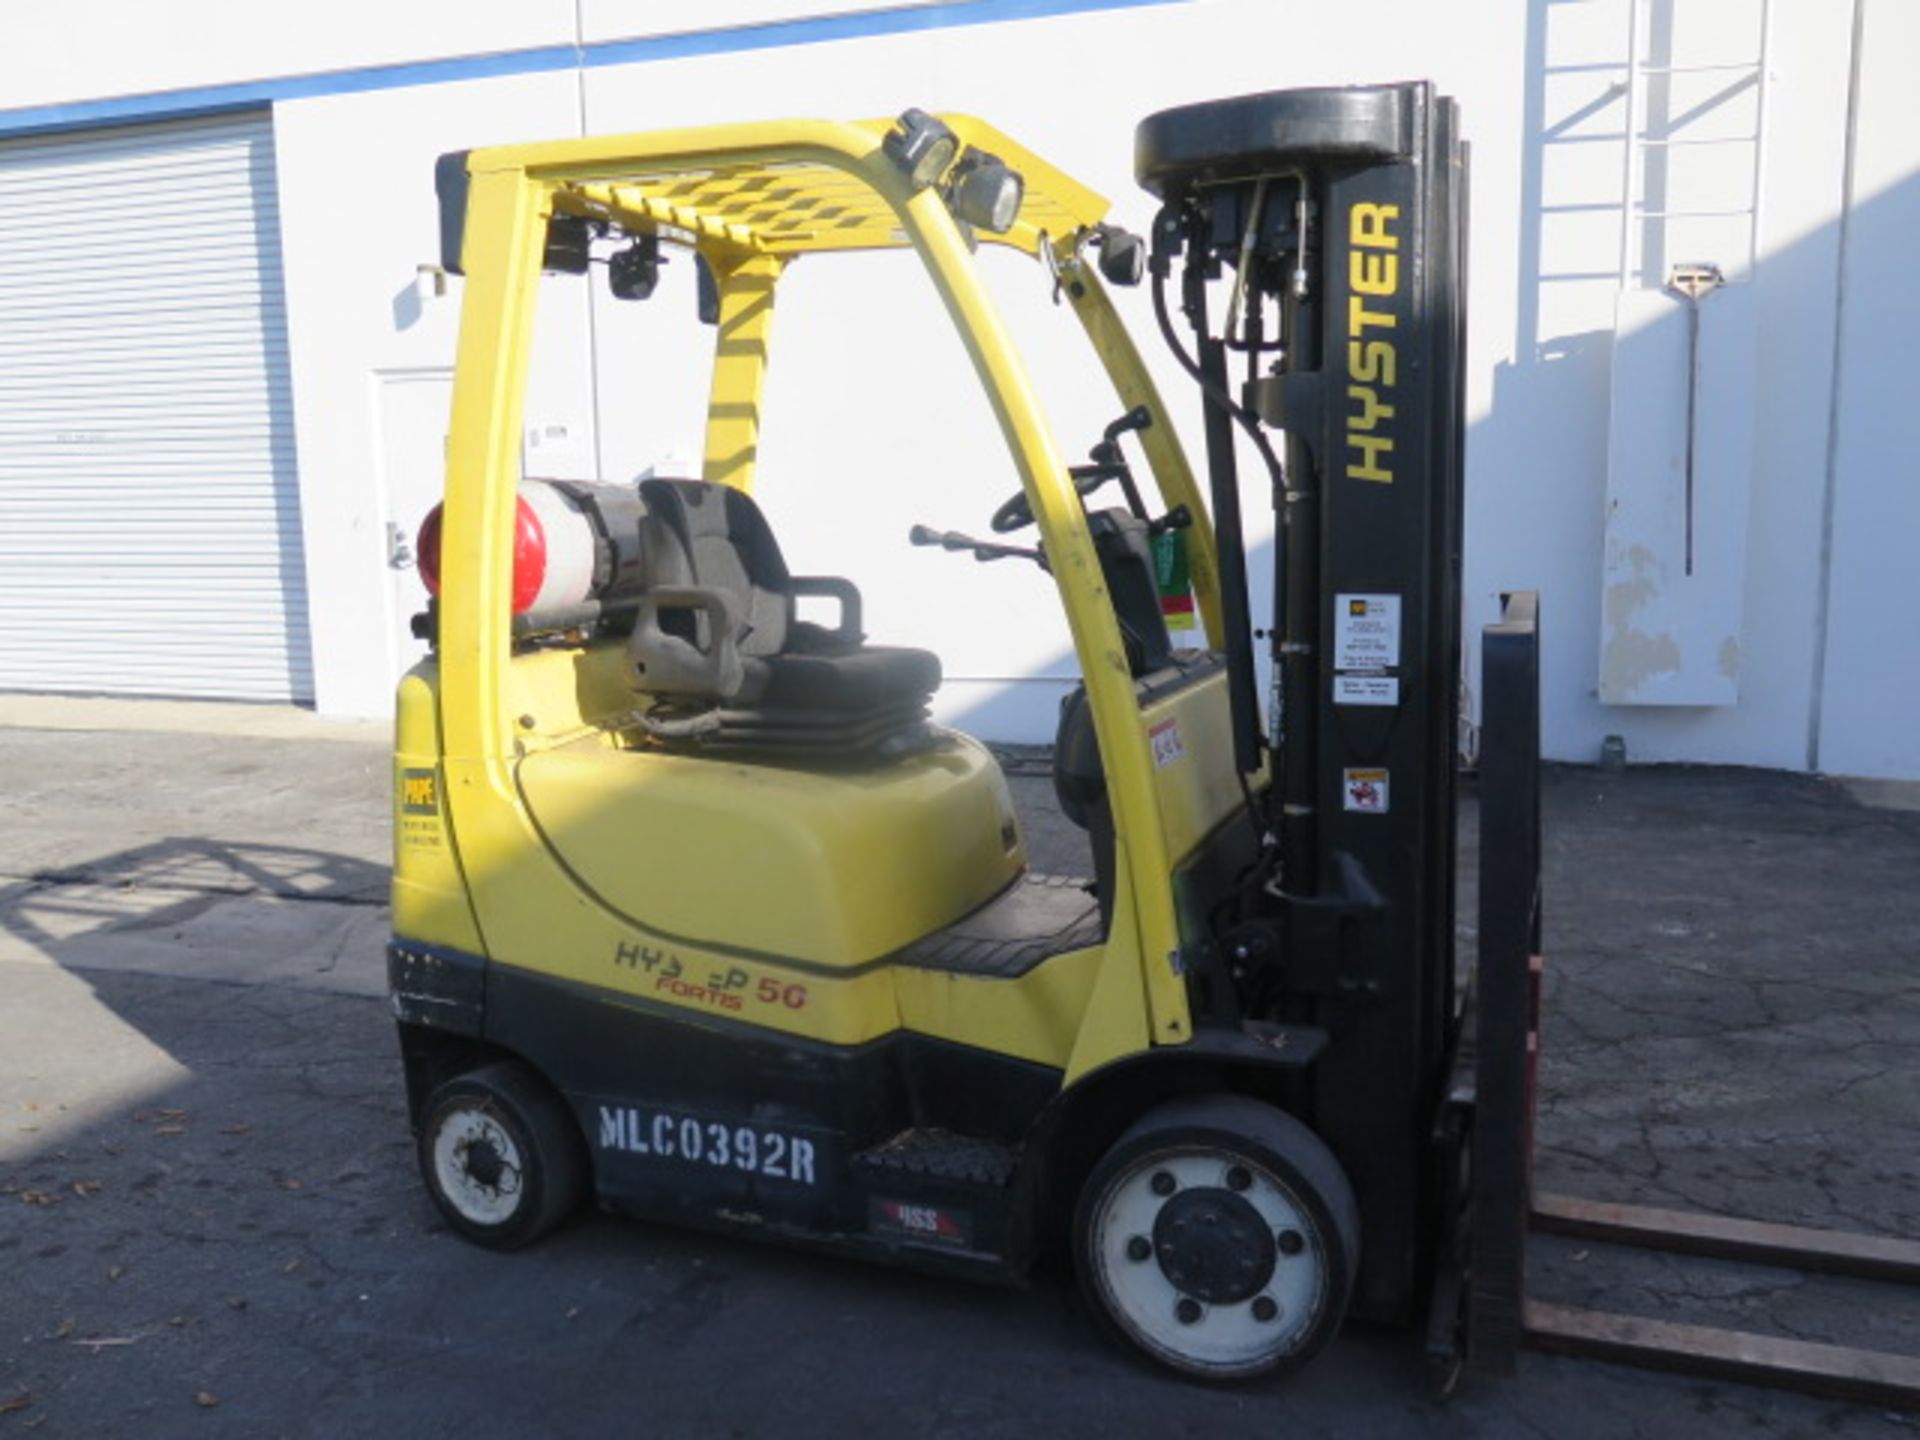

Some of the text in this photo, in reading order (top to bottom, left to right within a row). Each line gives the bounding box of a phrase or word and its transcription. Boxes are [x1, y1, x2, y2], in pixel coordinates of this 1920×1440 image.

[1346, 202, 1399, 484] HYSTER
[655, 976, 744, 1011] FORTIS
[599, 1106, 816, 1184] MLC0392R
